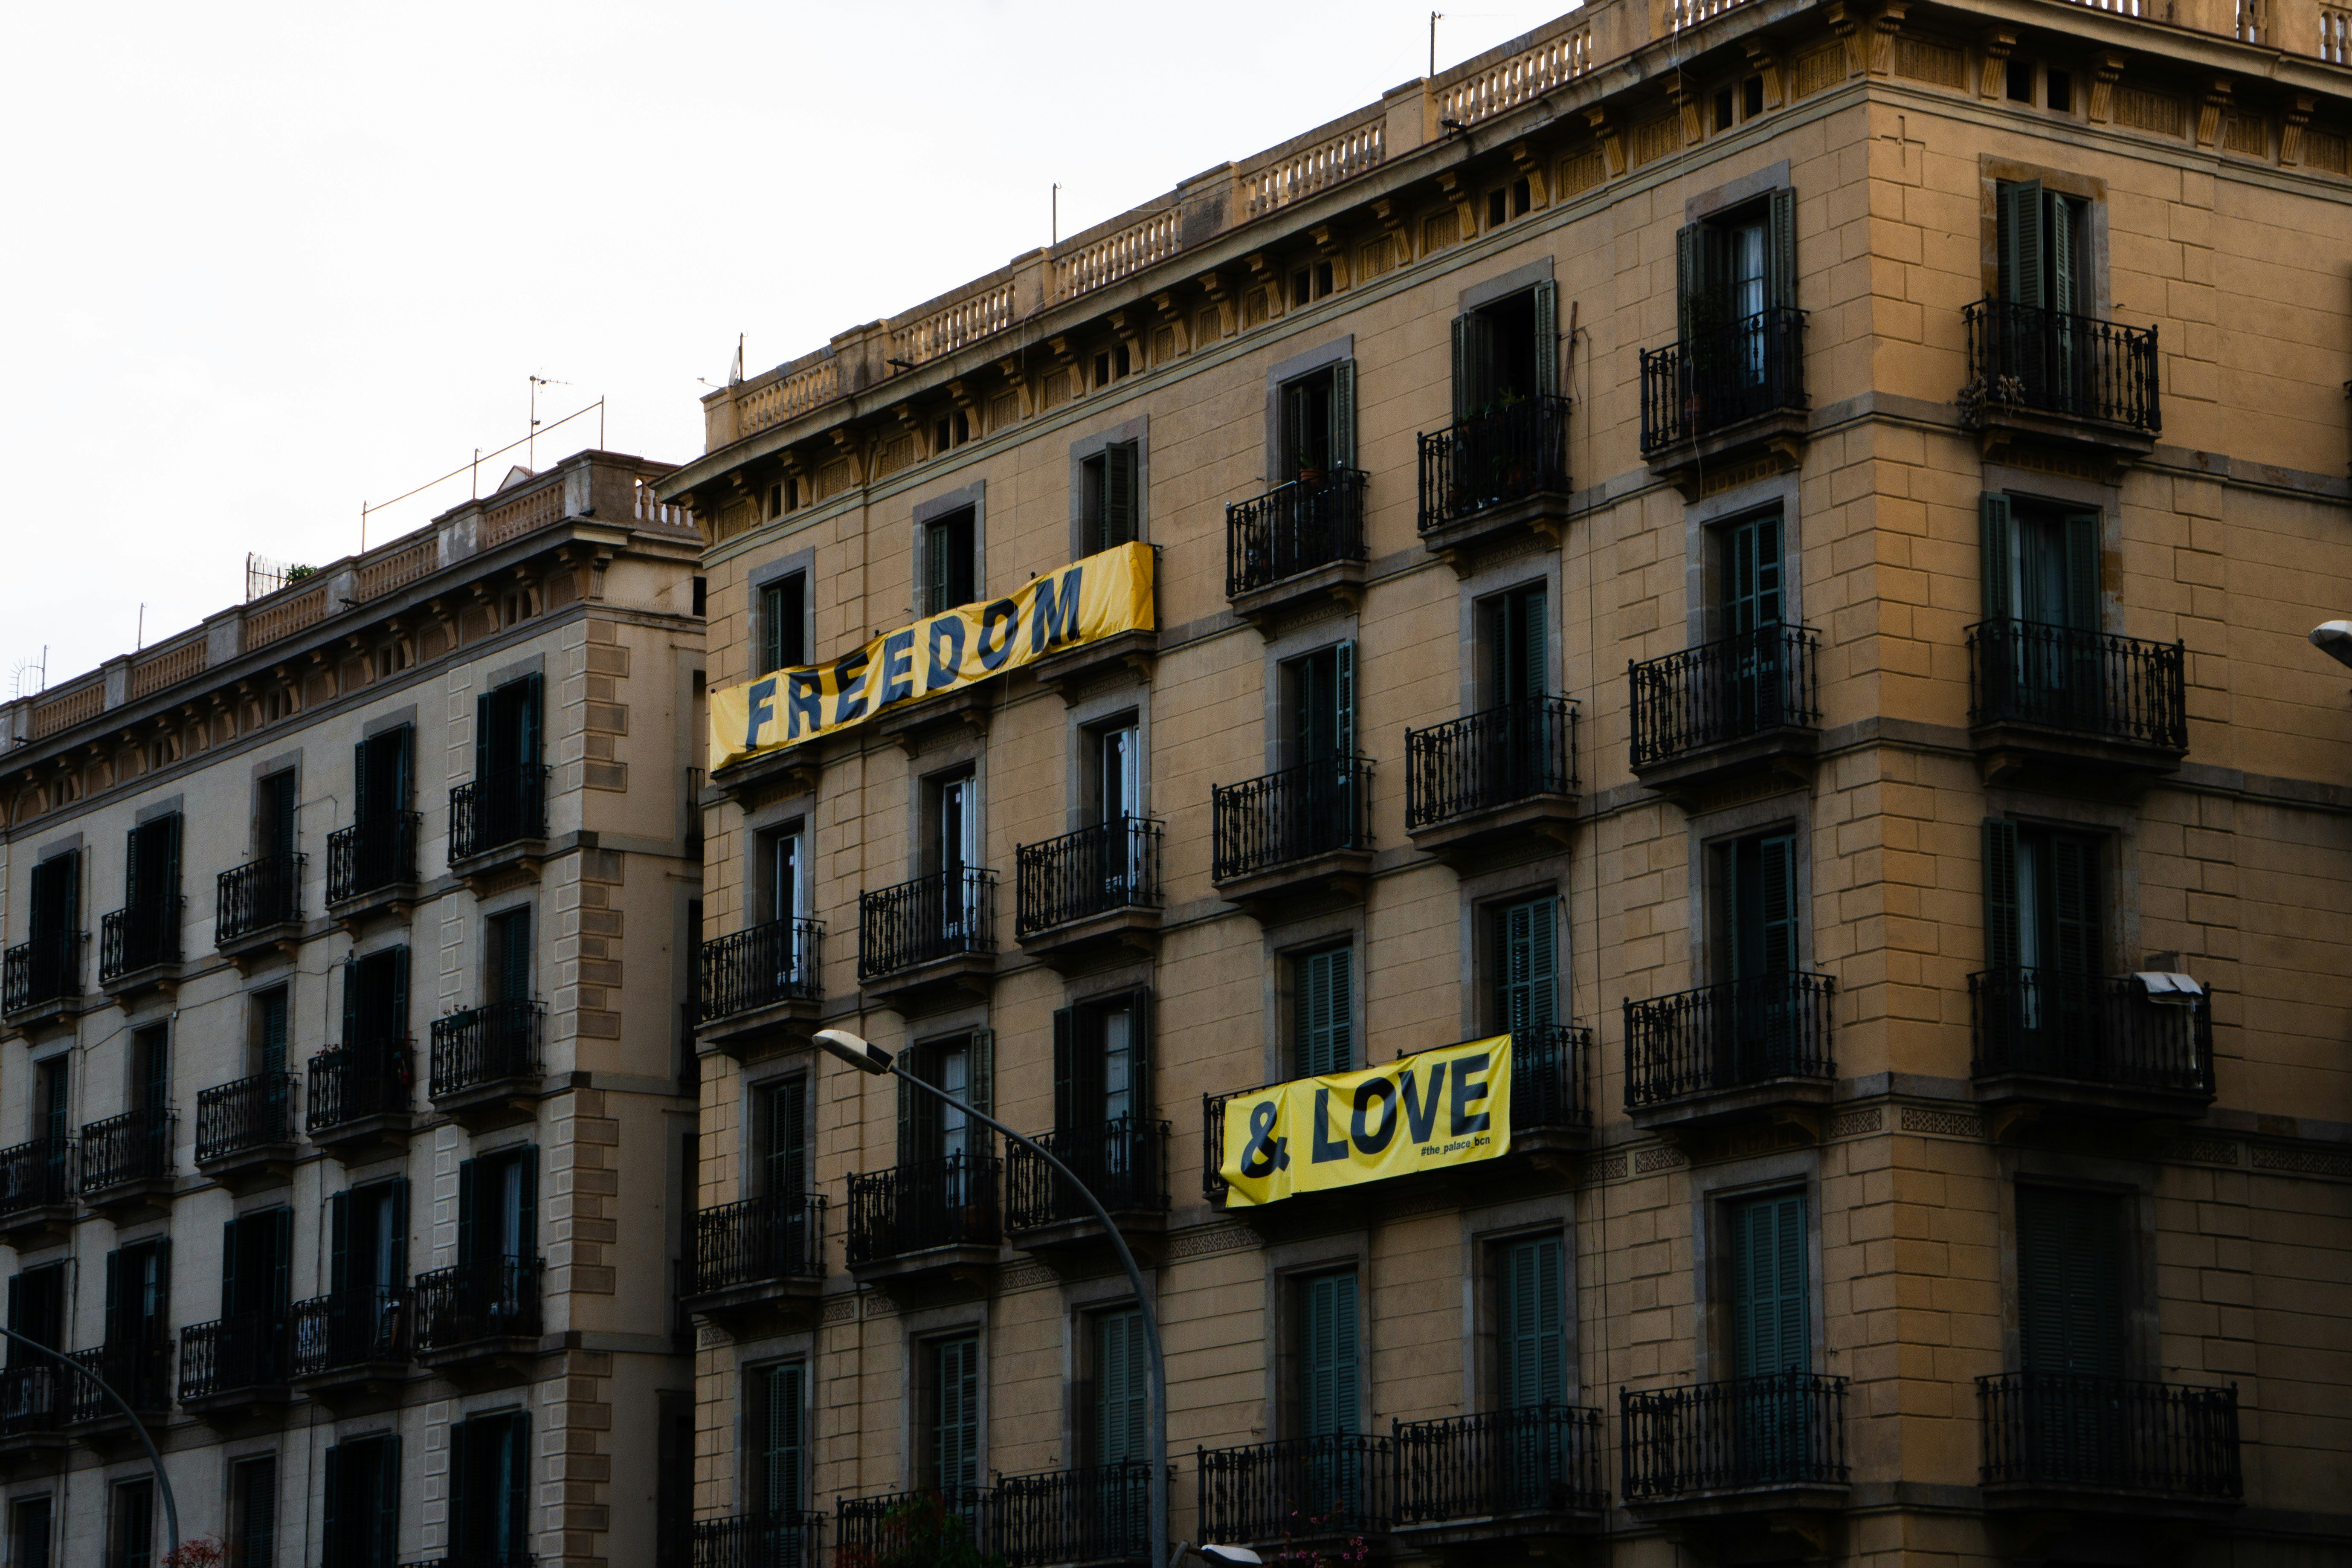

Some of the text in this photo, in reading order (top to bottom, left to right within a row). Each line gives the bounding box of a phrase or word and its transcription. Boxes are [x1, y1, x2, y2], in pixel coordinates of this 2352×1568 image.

[746, 566, 1082, 752] FREEDOM
[1241, 1053, 1491, 1178] & LOVE
[1421, 1136, 1490, 1156] #the_palace_bcn
